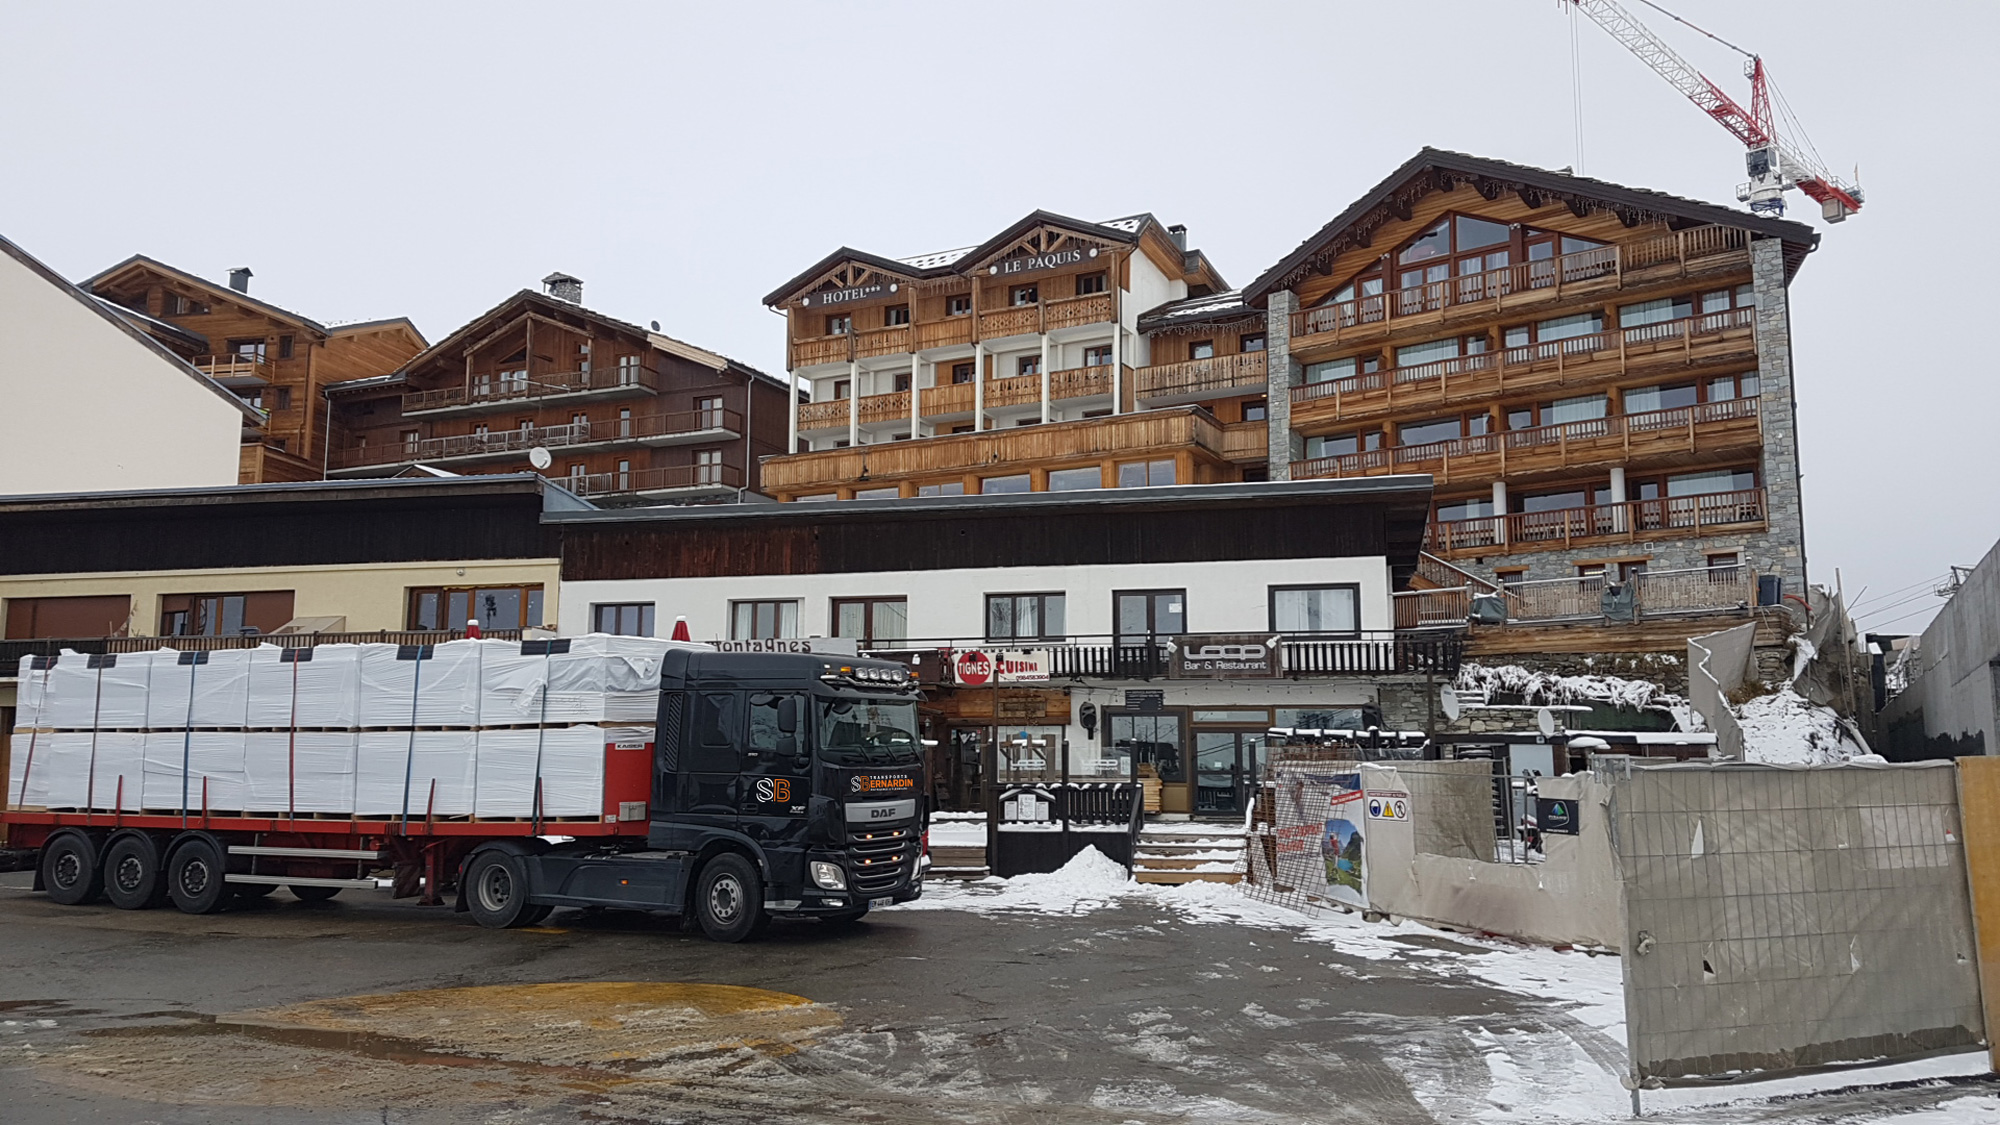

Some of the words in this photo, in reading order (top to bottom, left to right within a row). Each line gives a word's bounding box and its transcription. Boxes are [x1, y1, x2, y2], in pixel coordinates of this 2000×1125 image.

[1004, 261, 1021, 273] LE
[1027, 249, 1081, 269] PAQUIS
[1183, 645, 1266, 660] LOOP
[958, 661, 990, 676] TIGNES
[1184, 661, 1200, 670] Bar
[1204, 661, 1213, 670] &
[1216, 661, 1267, 670] Restaurant
[871, 808, 897, 818] DAF
